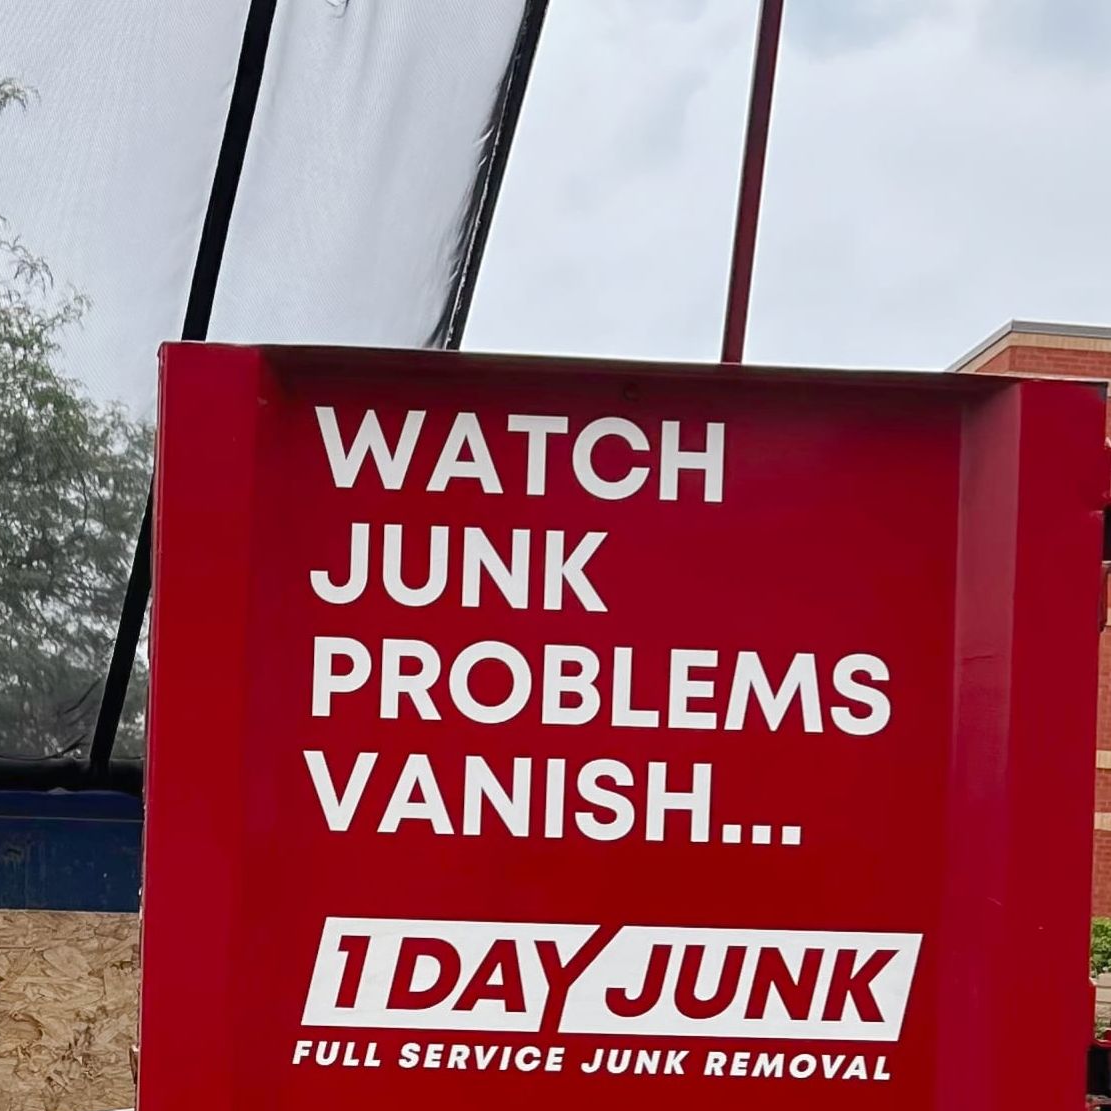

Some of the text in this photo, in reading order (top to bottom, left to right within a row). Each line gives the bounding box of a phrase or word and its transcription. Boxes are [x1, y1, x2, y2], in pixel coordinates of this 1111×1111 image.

[314, 406, 725, 503] WATCH
[309, 522, 608, 613] JUNK
[311, 636, 891, 736] PROBLEMS
[303, 750, 802, 846] VANISH...
[386, 925, 600, 1032] DAY
[605, 943, 900, 1023] JUNK
[292, 1040, 891, 1081] FULL SERVICE JUNK REMOVAL
